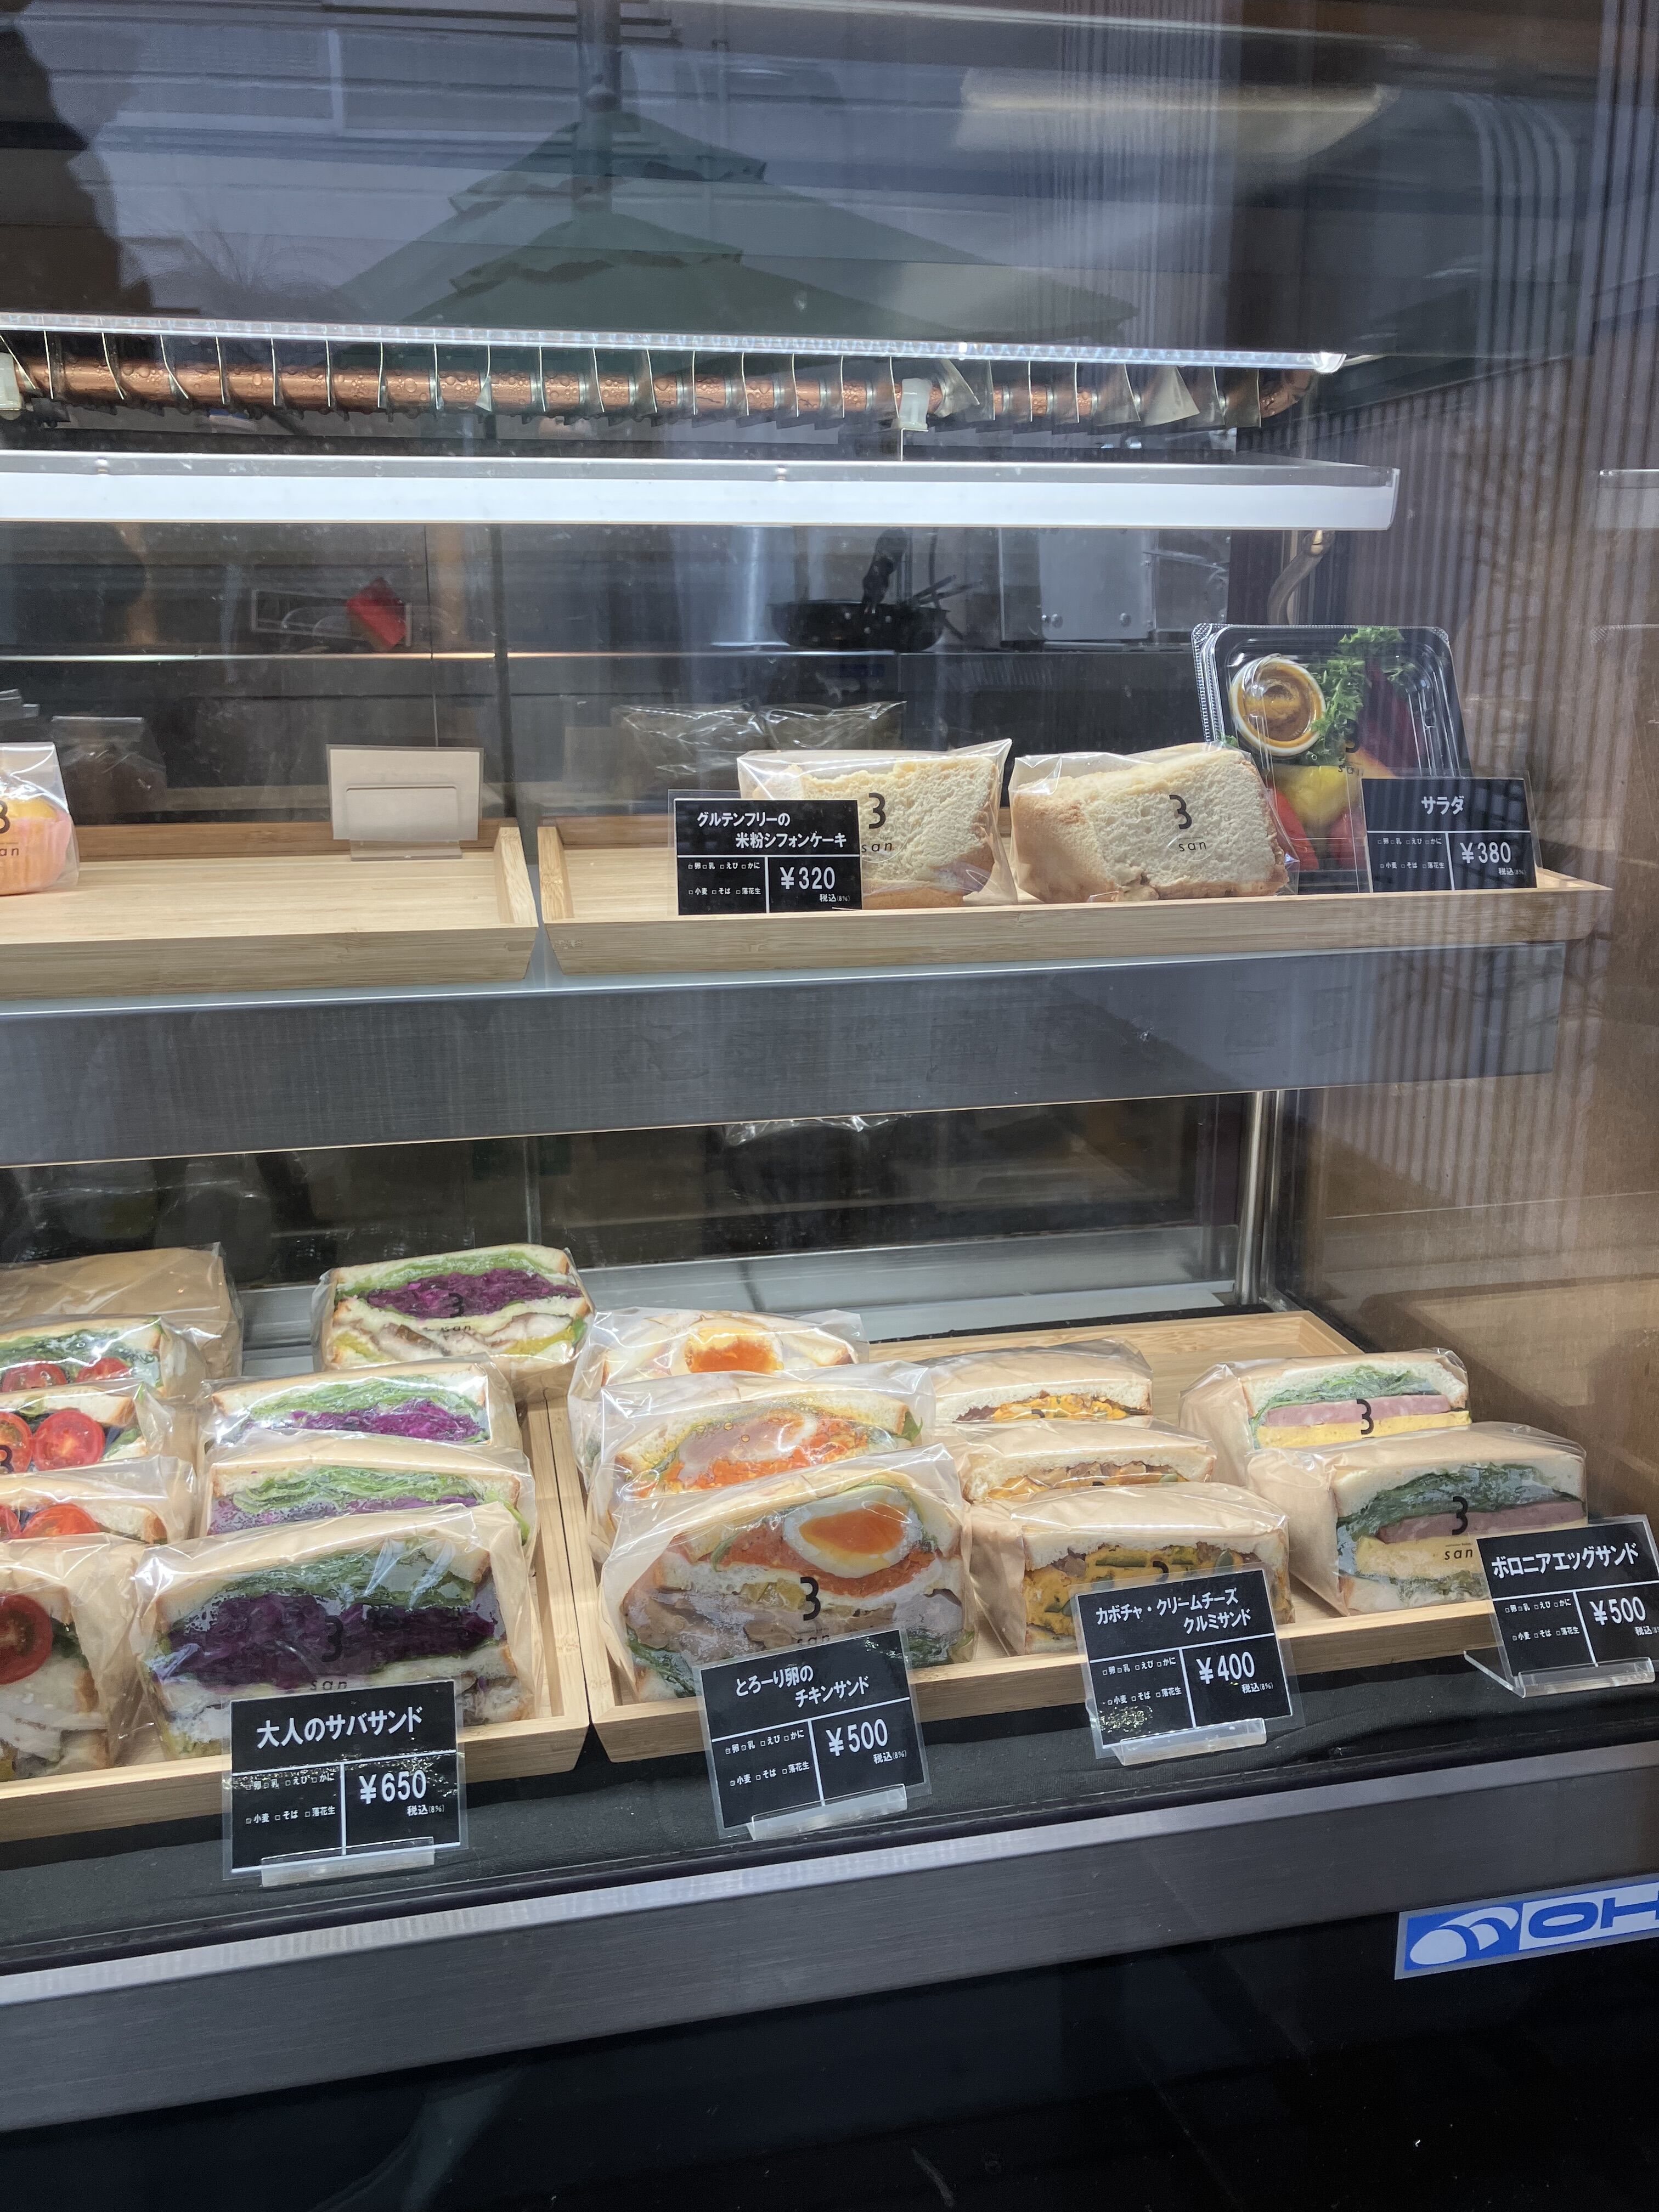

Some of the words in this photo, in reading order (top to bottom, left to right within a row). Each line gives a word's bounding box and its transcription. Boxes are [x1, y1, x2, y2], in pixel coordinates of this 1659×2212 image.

[697, 812, 791, 827] グルテンフリーの
[869, 793, 886, 829] 3
[1169, 794, 1192, 830] 3
[1421, 796, 1465, 815] サラダ
[735, 831, 847, 849] 米粉シフォンケーキ
[861, 842, 893, 853] san
[1178, 842, 1206, 852] san
[1460, 842, 1511, 864] ¥380
[780, 867, 836, 889] ¥320
[1356, 1398, 1374, 1435] 3
[1452, 1496, 1469, 1536] 3
[1444, 1549, 1473, 1560] san
[1491, 1542, 1639, 1579] ボロニアエッグサンド
[800, 1576, 821, 1621] 3
[1095, 1587, 1239, 1625] カボチャ・クリームチーズ
[1589, 1596, 1646, 1626] ¥500
[1183, 1608, 1251, 1634] クルミサンド
[321, 1615, 343, 1662] 3
[736, 1665, 814, 1696] とろーり卵の
[1197, 1651, 1255, 1684] ¥400
[310, 1680, 348, 1691] san
[794, 1676, 869, 1708] チキンサンド
[256, 1706, 423, 1749] 大人のサバサンド
[826, 1718, 888, 1756] ¥500
[359, 1769, 427, 1804] ¥650
